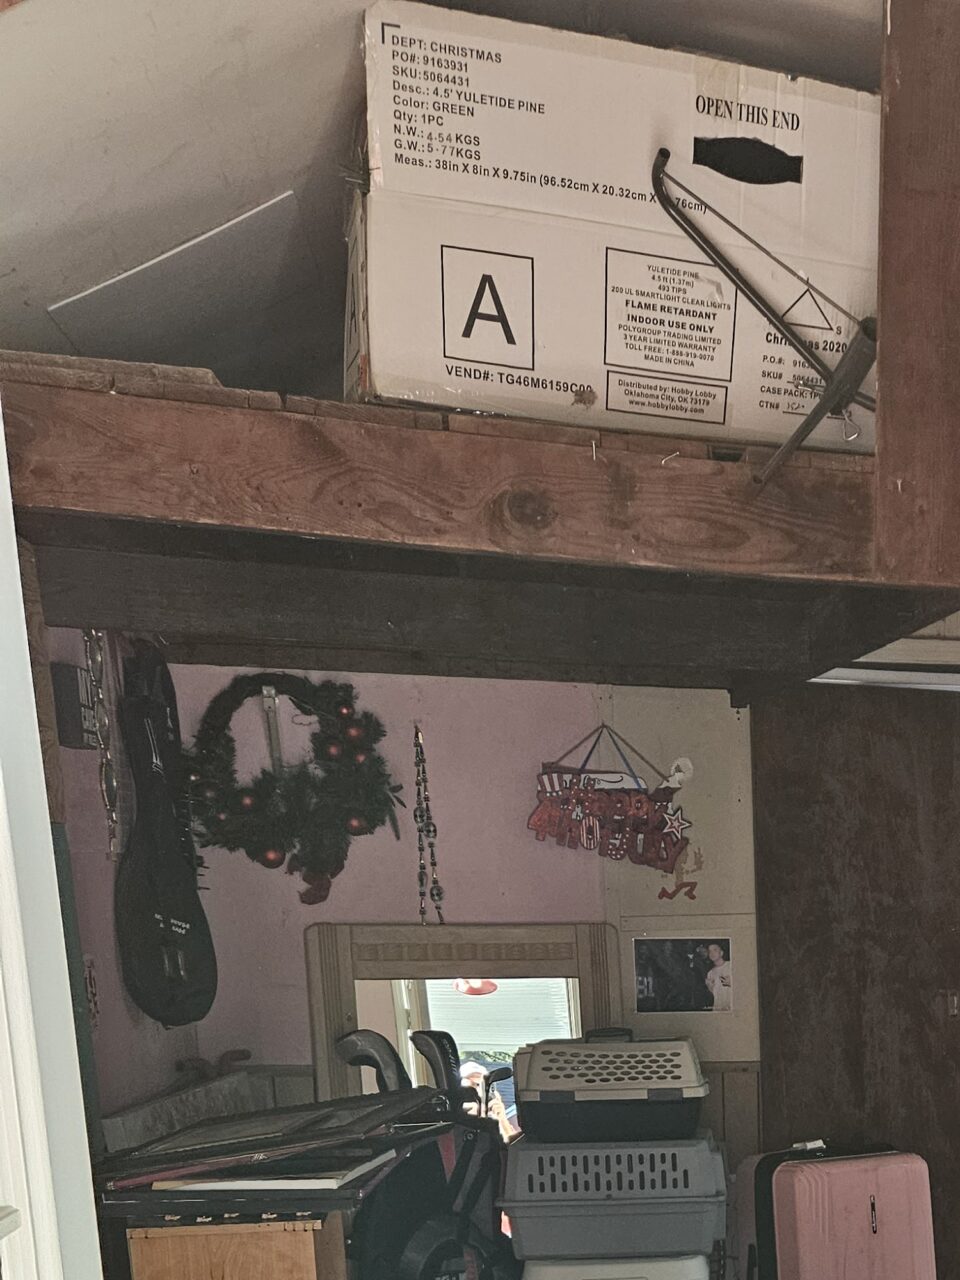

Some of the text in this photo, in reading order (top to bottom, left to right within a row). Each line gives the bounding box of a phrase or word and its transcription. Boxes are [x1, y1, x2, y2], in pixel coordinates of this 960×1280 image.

[392, 34, 502, 63] DEPT: CHRISTMAS
[392, 50, 469, 73] PO#: 9163931
[393, 80, 545, 115] Desc.: 4.5' YULETIDE PINE
[393, 94, 474, 117] Color: GREEN
[393, 109, 444, 127] Qty: 1PC
[695, 94, 800, 131] OPEN THIS END
[393, 123, 424, 138] N.W.:
[455, 133, 480, 147] KGS
[394, 138, 425, 153] G.W.:
[394, 153, 432, 169] Meas.:
[435, 159, 459, 172] 38in
[462, 163, 470, 174] X
[472, 164, 490, 177] 8in
[492, 167, 500, 179] X
[502, 168, 537, 184] 9.75in
[539, 174, 590, 192] (96.52cm
[592, 182, 600, 194] X
[602, 184, 647, 202] 20.32cm
[647, 264, 700, 280] YULETIDE PINE
[635, 289, 681, 304] SMARTLIGHT
[681, 297, 705, 308] CLEAR
[671, 286, 687, 295] TIPS
[461, 273, 517, 346] A
[625, 299, 718, 321] FLAME RETARDANT
[618, 323, 722, 345] POLYGROUP TRADING LIMITED
[627, 313, 715, 334] INDOOR USE ONLY
[625, 342, 642, 351] TOLL
[643, 345, 664, 355] FREE:
[628, 334, 648, 343] YEAR
[649, 337, 677, 348] LIMITED
[677, 340, 717, 353] WARRANTY
[643, 353, 695, 368] MADE IN CHINA
[445, 364, 494, 382] VEND#:
[618, 379, 658, 392] Distributed
[671, 386, 694, 397] Hobby
[695, 390, 717, 400] Lobby
[624, 388, 660, 400] Oklahoma
[677, 396, 689, 404] OK
[628, 399, 705, 414] www.hobbylobby.com
